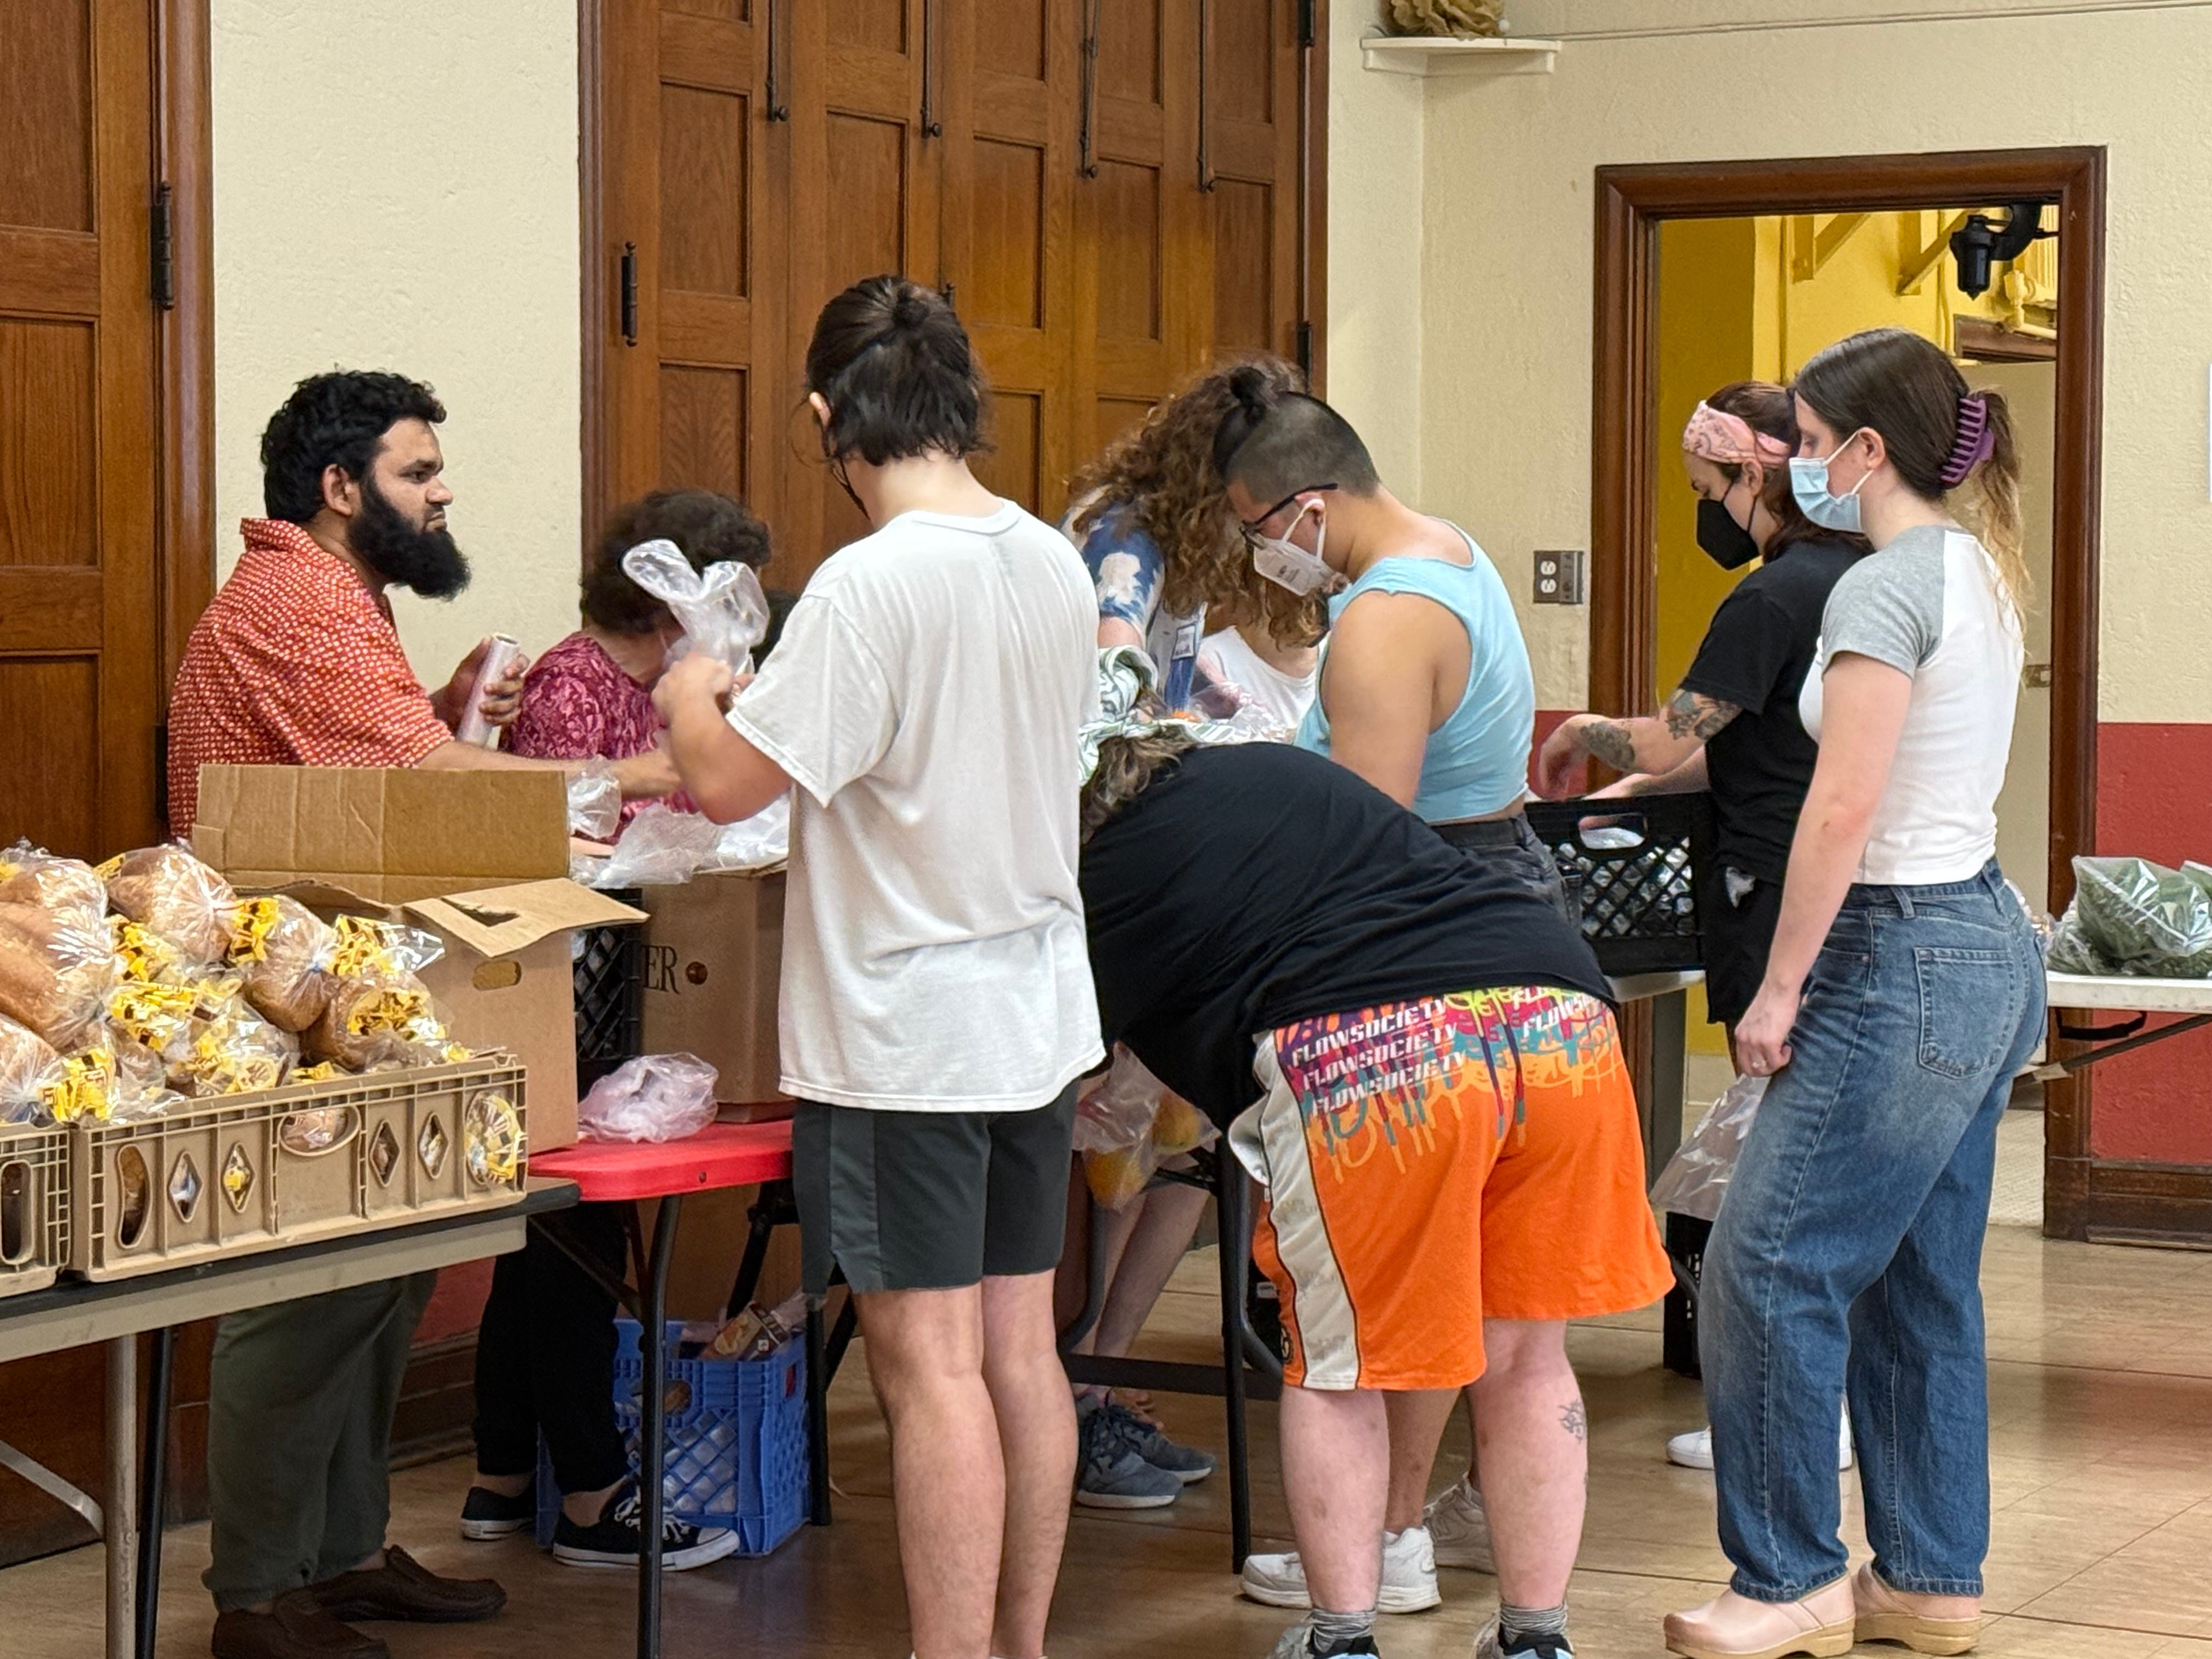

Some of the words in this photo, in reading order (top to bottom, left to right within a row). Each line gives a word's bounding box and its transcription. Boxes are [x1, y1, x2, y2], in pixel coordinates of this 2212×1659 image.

[1292, 998, 1447, 1068] FLOWSOCIETY
[1303, 1022, 1457, 1091] FLOWSOCIETY
[1312, 1050, 1466, 1117] FLOWSOCIETY
